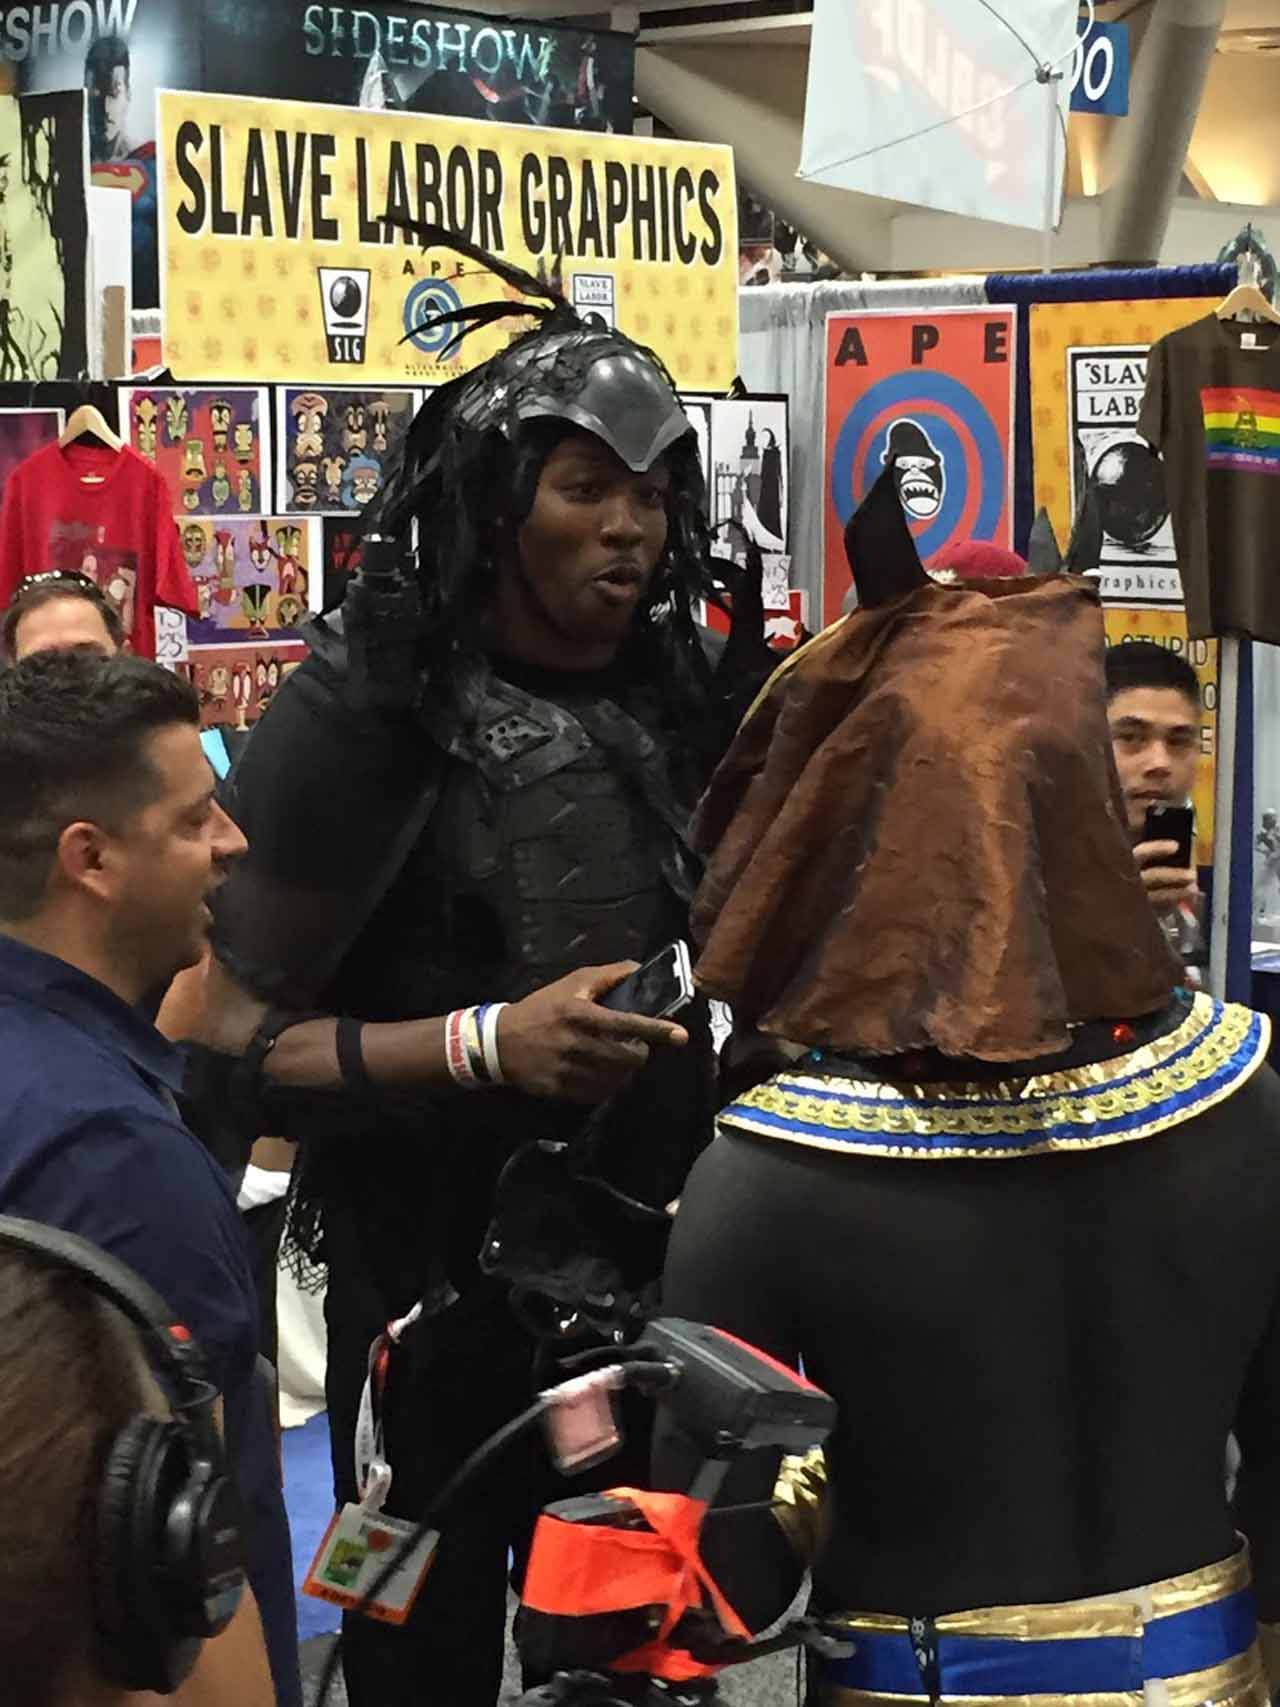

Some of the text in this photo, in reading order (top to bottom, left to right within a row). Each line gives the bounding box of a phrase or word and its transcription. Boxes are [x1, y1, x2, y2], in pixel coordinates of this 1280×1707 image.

[0, 0, 138, 61] SHOW
[303, 5, 553, 82] SIDESHOW
[176, 120, 722, 266] SLAVE LABOR GRAPHICS
[402, 259, 465, 277] APE
[334, 337, 361, 362] SLG
[835, 322, 1008, 366] APE
[1085, 362, 1149, 385] SLAV
[1089, 396, 1138, 416] LAB
[1103, 574, 1177, 591] raphics
